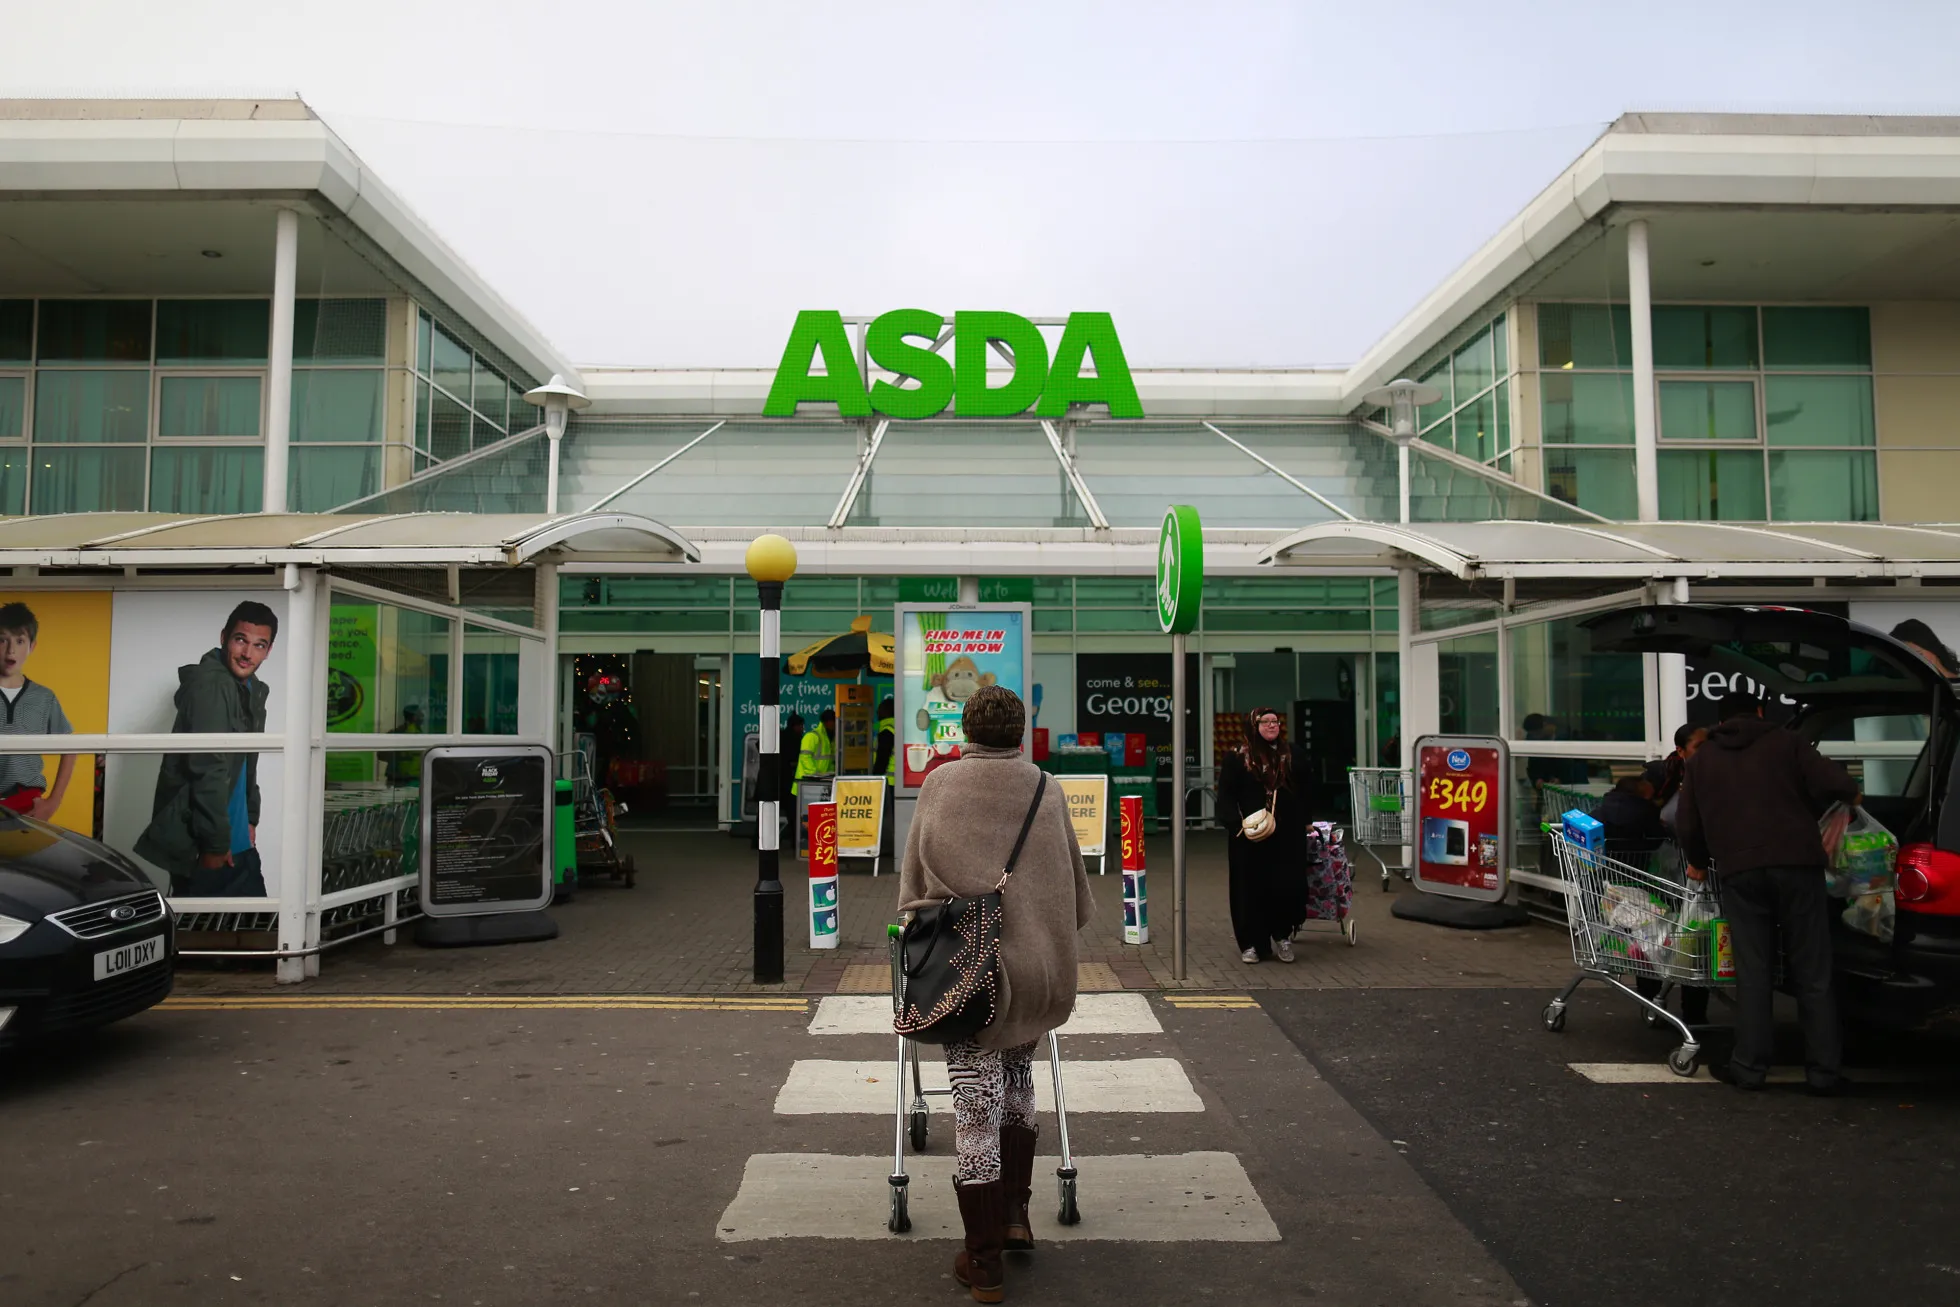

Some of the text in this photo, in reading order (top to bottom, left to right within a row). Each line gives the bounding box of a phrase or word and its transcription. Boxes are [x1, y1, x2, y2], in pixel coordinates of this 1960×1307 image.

[762, 308, 1144, 419] ASDA
[994, 581, 1009, 600] to
[925, 630, 1005, 641] FIND ME IN
[925, 643, 1003, 653] ASDA NOW
[1086, 678, 1121, 688] come
[1124, 676, 1134, 688] &
[798, 680, 832, 698] time,
[940, 725, 957, 737] PG
[843, 795, 872, 806] JOIN
[1429, 777, 1488, 813] £349
[840, 808, 873, 819] HERE
[134, 940, 156, 965] DXY
